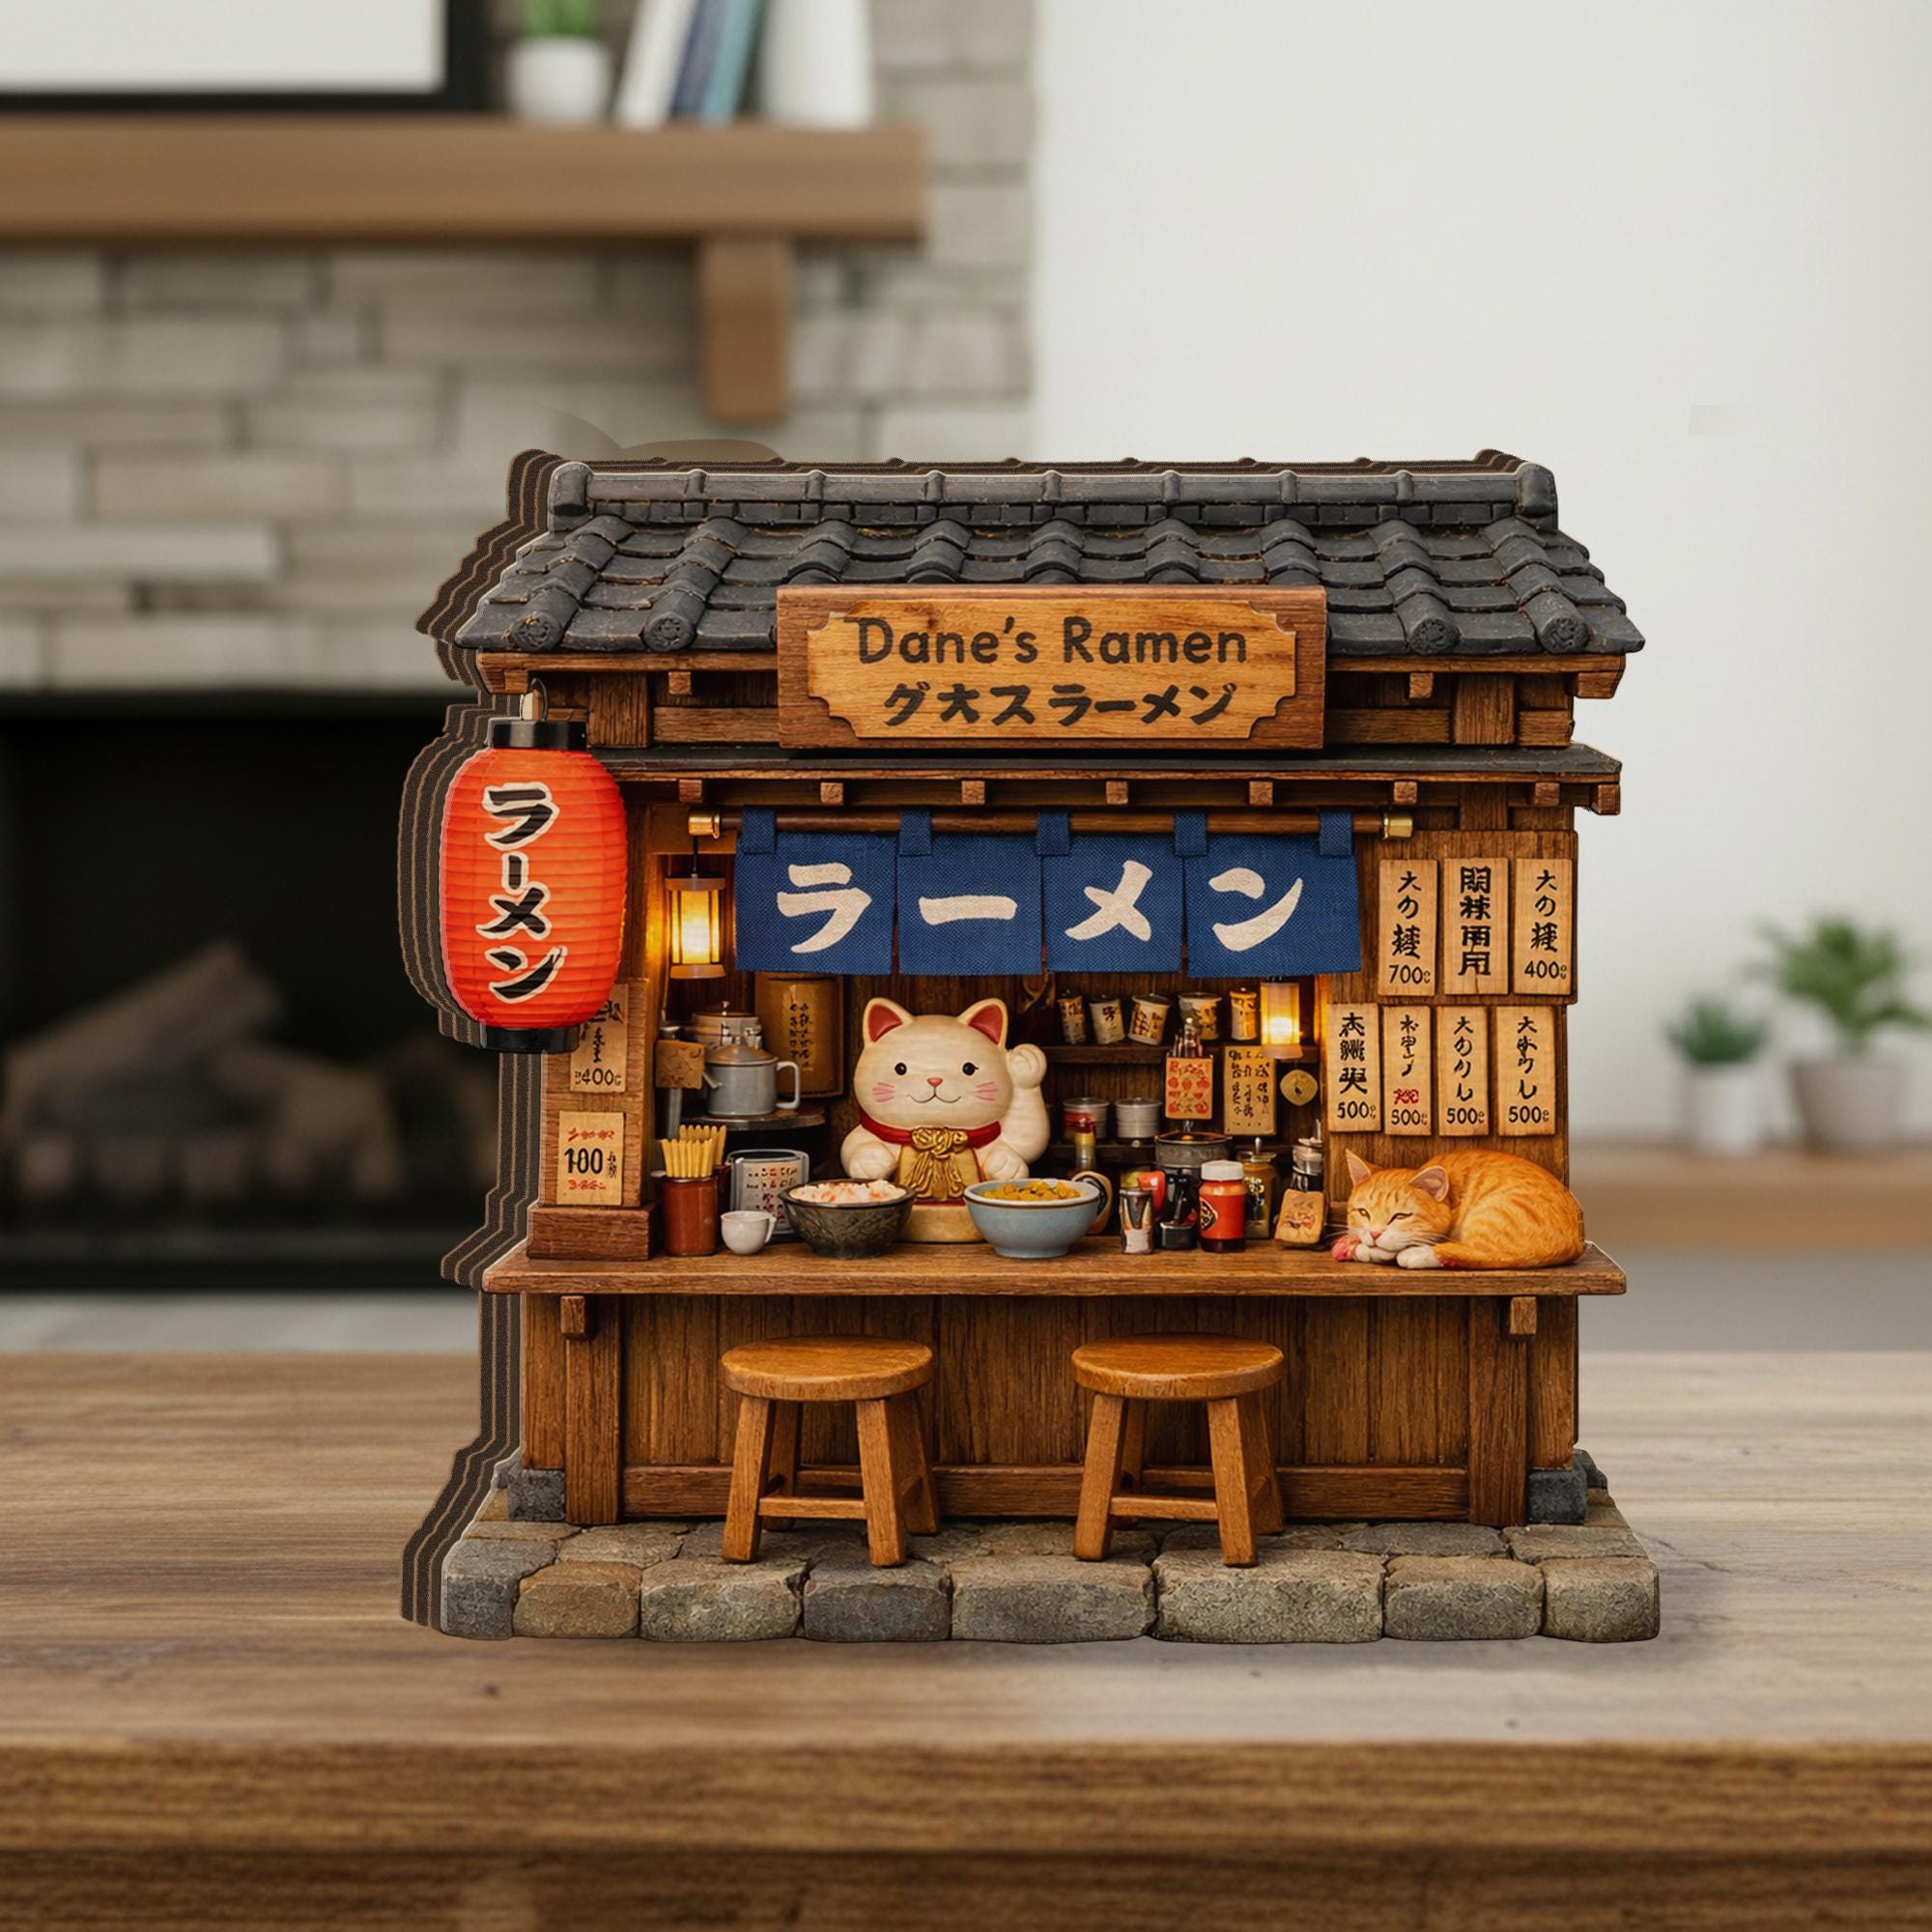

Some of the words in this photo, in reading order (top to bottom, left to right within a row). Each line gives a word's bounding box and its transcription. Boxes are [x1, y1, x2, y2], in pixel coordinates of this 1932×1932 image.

[843, 616, 1038, 665] Dane's
[1064, 616, 1247, 665] Ramen
[477, 781, 567, 1004] ラーメン
[777, 860, 1303, 952] ラーメン
